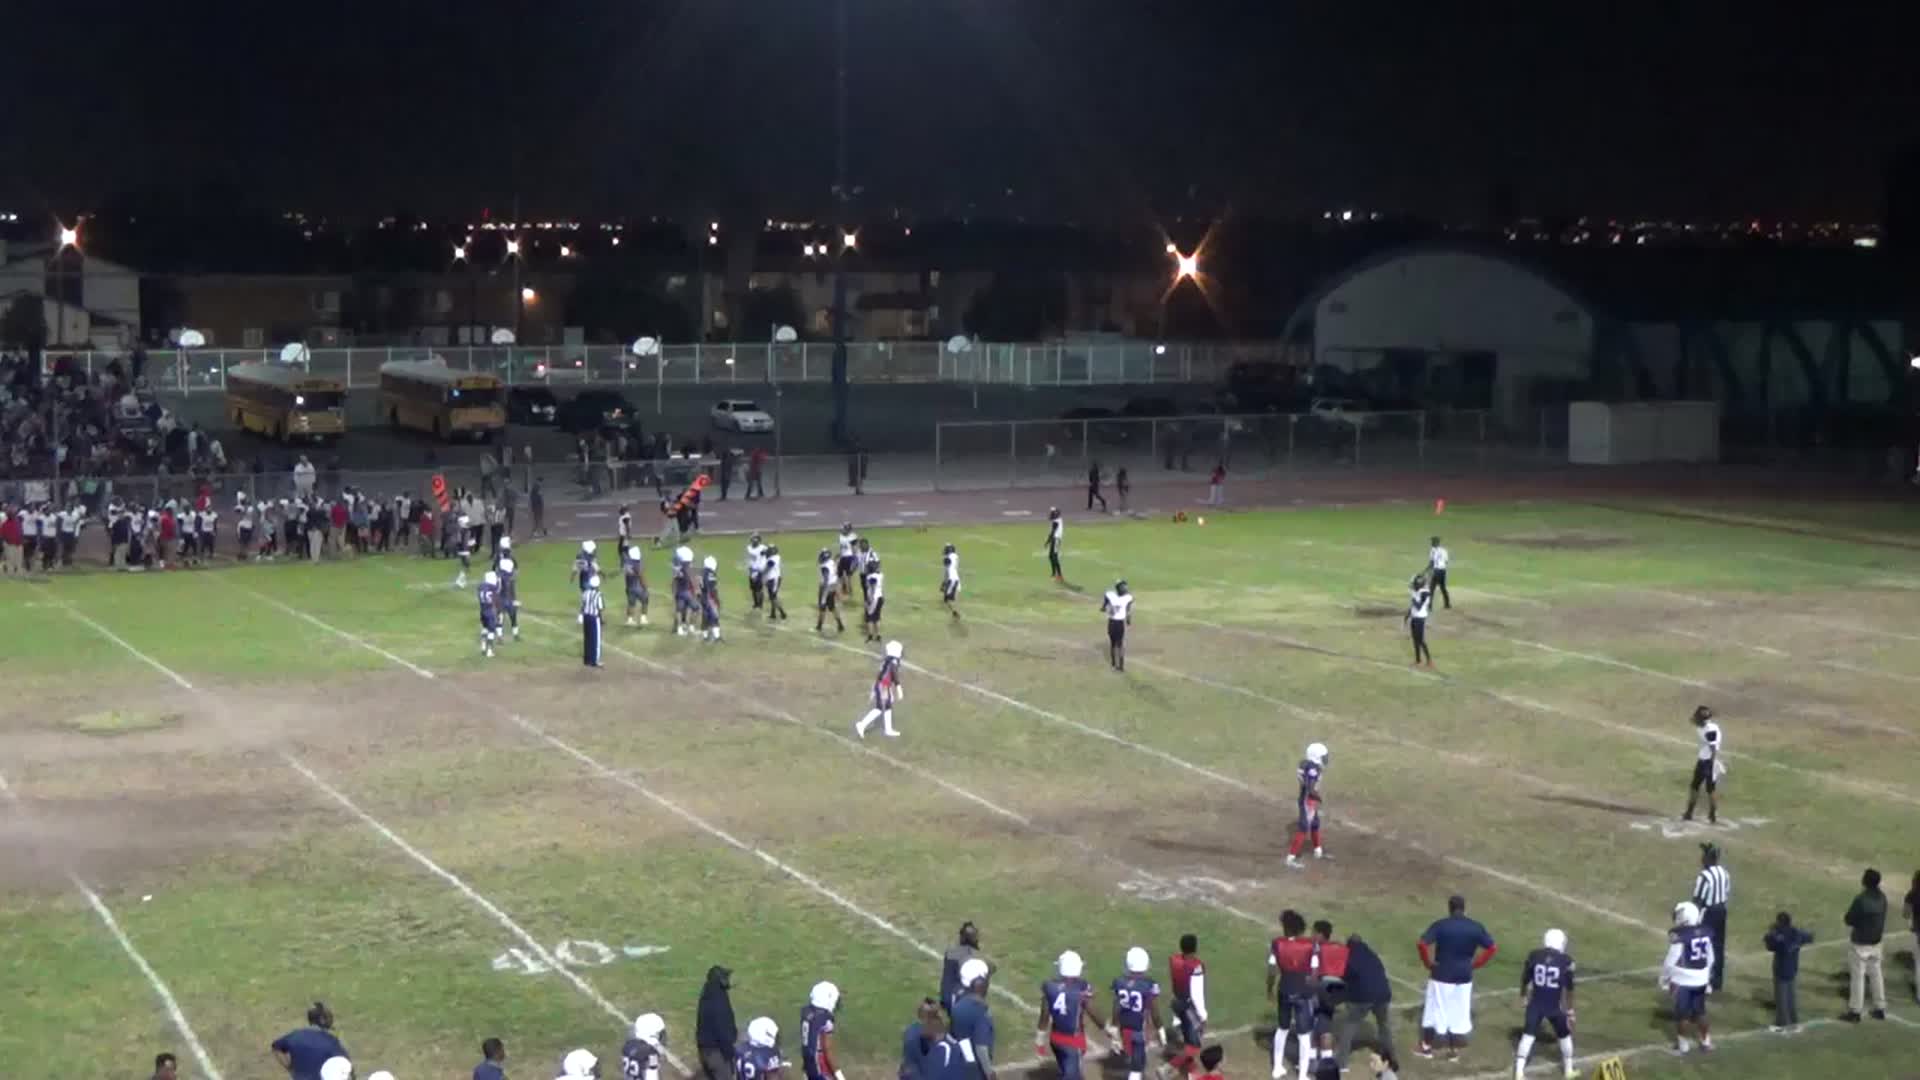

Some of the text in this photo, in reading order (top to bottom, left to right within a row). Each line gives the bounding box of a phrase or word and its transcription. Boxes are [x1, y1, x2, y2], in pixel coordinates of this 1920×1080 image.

[1690, 936, 1711, 960] 53
[1534, 964, 1560, 988] 82
[1053, 992, 1067, 1015] 4
[1118, 989, 1143, 1012] 23
